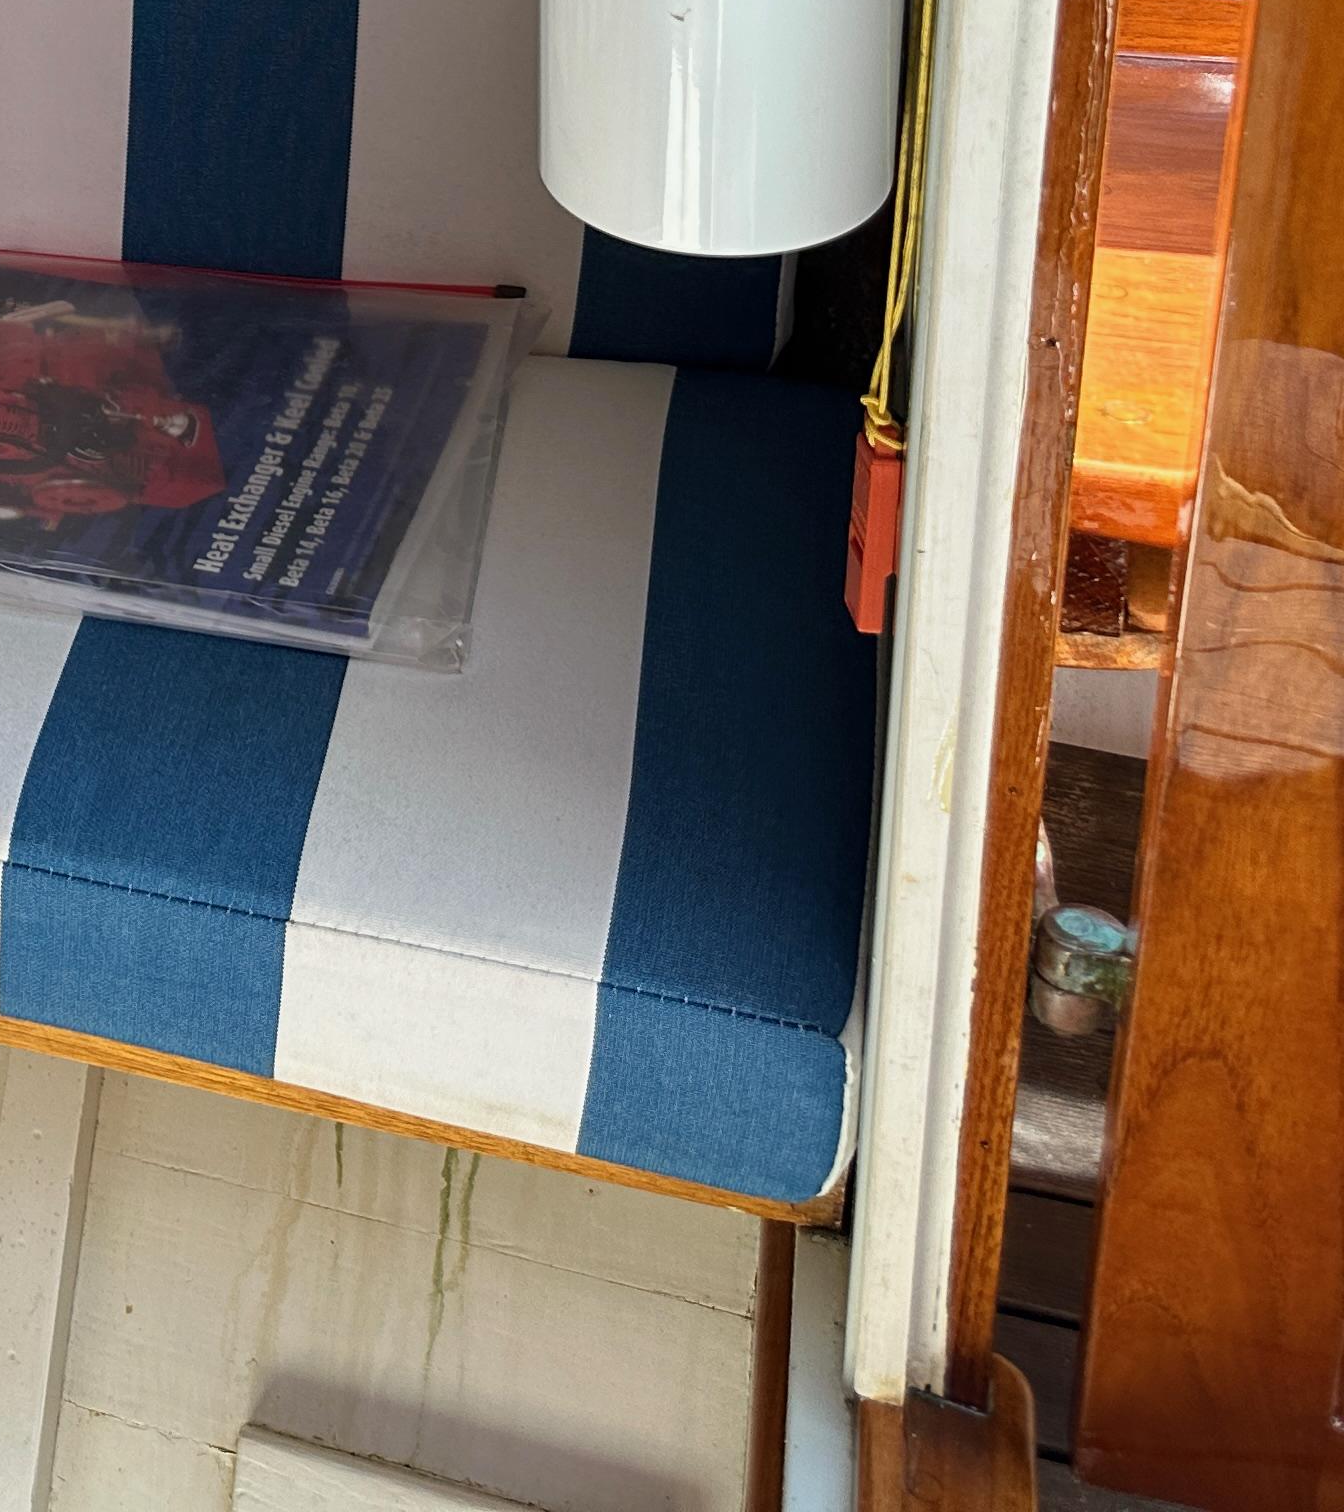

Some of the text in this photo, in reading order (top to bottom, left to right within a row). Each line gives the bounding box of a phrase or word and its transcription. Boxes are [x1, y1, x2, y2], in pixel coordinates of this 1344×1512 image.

[273, 392, 313, 429] Keel
[358, 403, 386, 430] Beta
[265, 431, 293, 445] &
[331, 458, 360, 486] Beta
[218, 447, 285, 530] Exchanger
[242, 546, 277, 581] Small
[262, 508, 297, 546] Diesel
[281, 469, 317, 508] Engine
[322, 401, 351, 428] Beta
[321, 487, 350, 504] 16,
[305, 506, 336, 536] Beta
[192, 532, 240, 574] Heat
[295, 537, 325, 555] 14,
[278, 556, 310, 587] Beta
